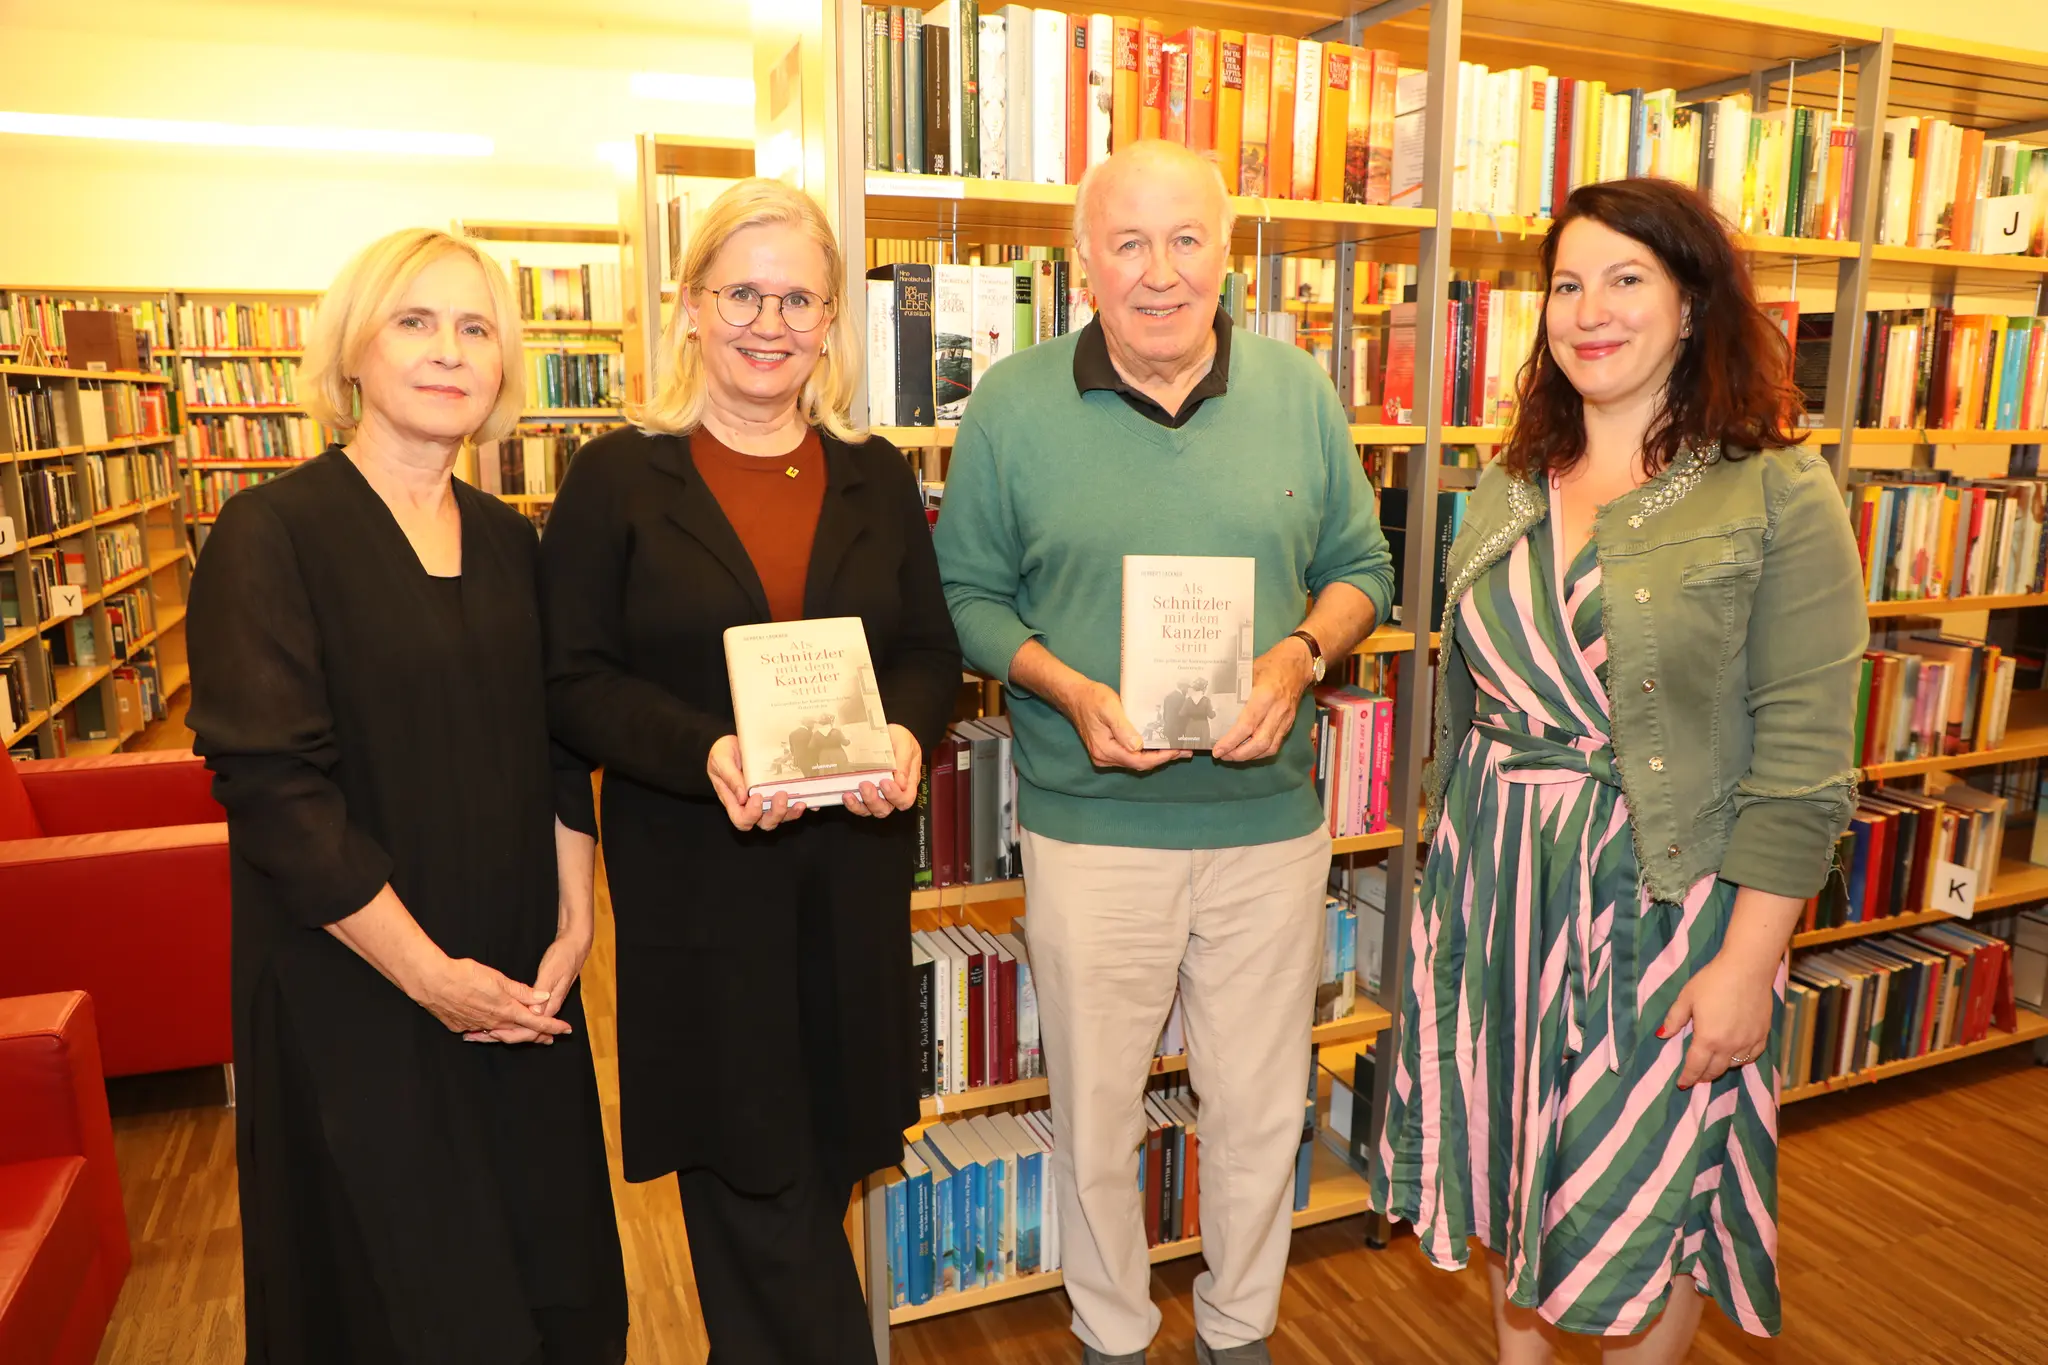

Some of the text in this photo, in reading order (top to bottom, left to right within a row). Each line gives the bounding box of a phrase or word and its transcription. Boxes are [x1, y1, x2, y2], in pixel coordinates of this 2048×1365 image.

[2003, 211, 2019, 236] J
[905, 292, 928, 300] ACHTE
[900, 300, 931, 310] LEBEN
[1183, 583, 1204, 595] Als
[64, 594, 75, 606] Y
[1153, 595, 1232, 611] Schnitzler
[1164, 612, 1219, 625] mit dem
[1162, 625, 1222, 640] Kanzler
[790, 641, 813, 650] Als
[1174, 642, 1208, 653] stritt
[760, 648, 845, 665] Schnitzler
[776, 661, 835, 675] mit dem
[775, 671, 840, 687] Kanzler
[791, 684, 828, 696] stritt
[918, 815, 927, 868] Bettina Haskamp
[1948, 878, 1967, 903] K
[920, 973, 928, 995] Farben
[919, 1017, 929, 1033] Welt
[919, 1033, 929, 1046] Die
